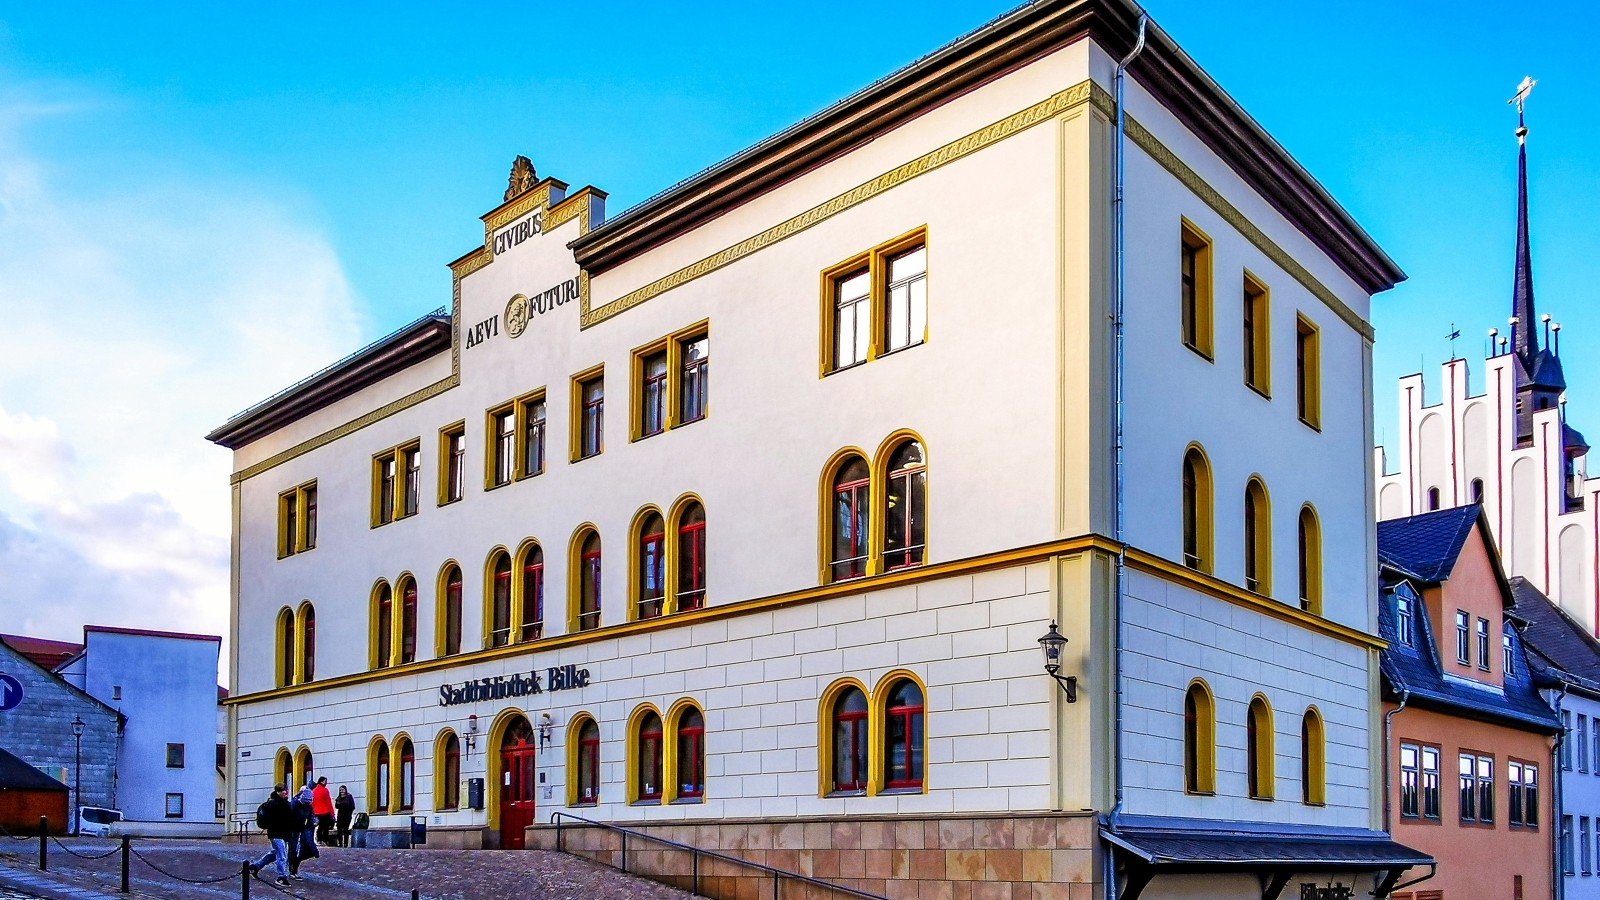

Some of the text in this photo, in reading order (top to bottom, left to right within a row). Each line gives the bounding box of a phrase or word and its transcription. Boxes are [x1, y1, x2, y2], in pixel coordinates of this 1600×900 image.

[493, 212, 542, 256] CIVIBUS
[466, 275, 581, 349] AEVI FUTURI
[439, 664, 590, 706] Stadtbibliothek Bilke
